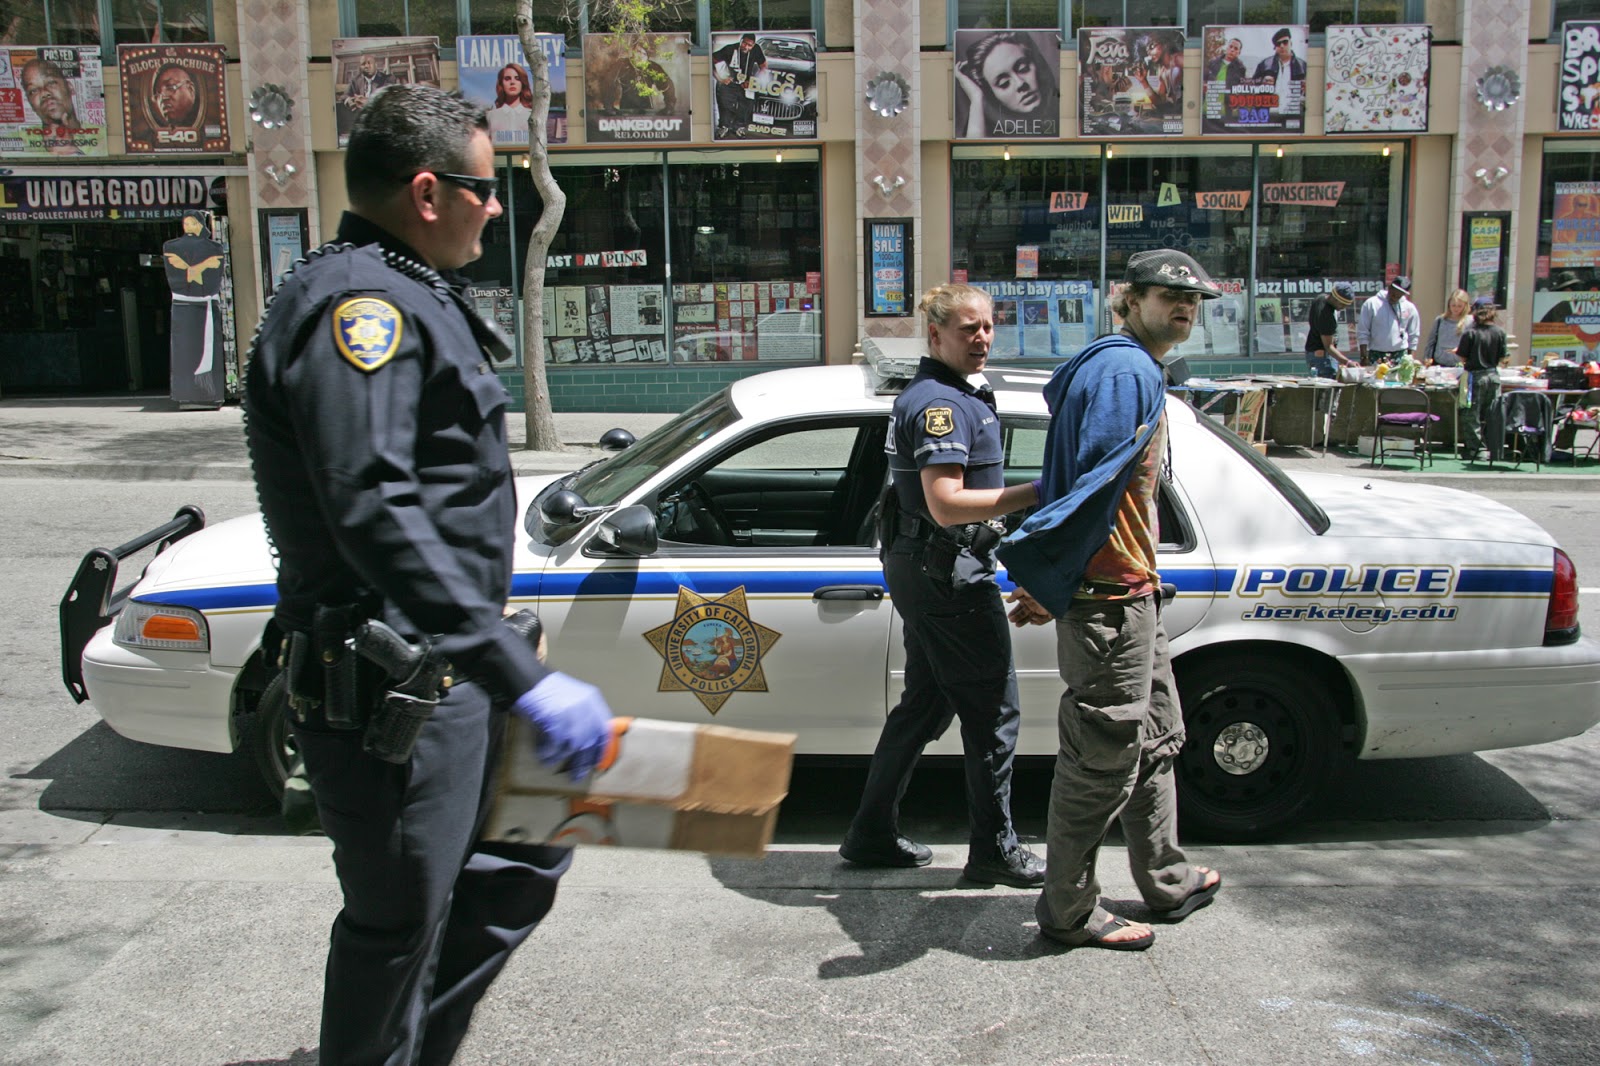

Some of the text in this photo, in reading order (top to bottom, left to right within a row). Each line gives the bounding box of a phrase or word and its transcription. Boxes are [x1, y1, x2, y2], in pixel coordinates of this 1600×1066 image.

[461, 38, 502, 67] LANA
[537, 38, 562, 67] EY
[129, 59, 160, 74] BLOCK
[1562, 56, 1600, 84] SP
[1232, 84, 1275, 93] HOLLYWOOD
[1239, 108, 1270, 123] BAG
[599, 119, 682, 131] DANKED OUT
[748, 124, 770, 133] SHAD
[993, 119, 1056, 134] ADELE 21
[158, 131, 197, 142] E-40
[26, 179, 203, 208] UNDERGROUND
[1164, 186, 1172, 202] A
[1264, 184, 1338, 201] CONSCIENCE
[1054, 192, 1082, 209] ART
[1202, 193, 1242, 208] SOCIAL
[91, 210, 103, 218] LPS
[124, 209, 135, 217] IN
[140, 209, 159, 218] THE
[1109, 206, 1141, 220] WITH
[875, 224, 902, 238] VINYL
[1472, 226, 1500, 235] CASH
[875, 240, 902, 253] SALE
[546, 254, 600, 267] AST BAY
[606, 251, 643, 264] PUNK
[986, 282, 1088, 298] in the bay area
[1255, 279, 1281, 295] jazz
[1284, 279, 1297, 293] in
[1299, 279, 1322, 293] the
[1353, 281, 1384, 293] area
[1243, 569, 1450, 593] POLICE
[1244, 605, 1457, 622] .berkeley.edu
[670, 608, 756, 671] UNIVERSITY OF CALIFORNIA
[690, 677, 737, 691] POLICE
